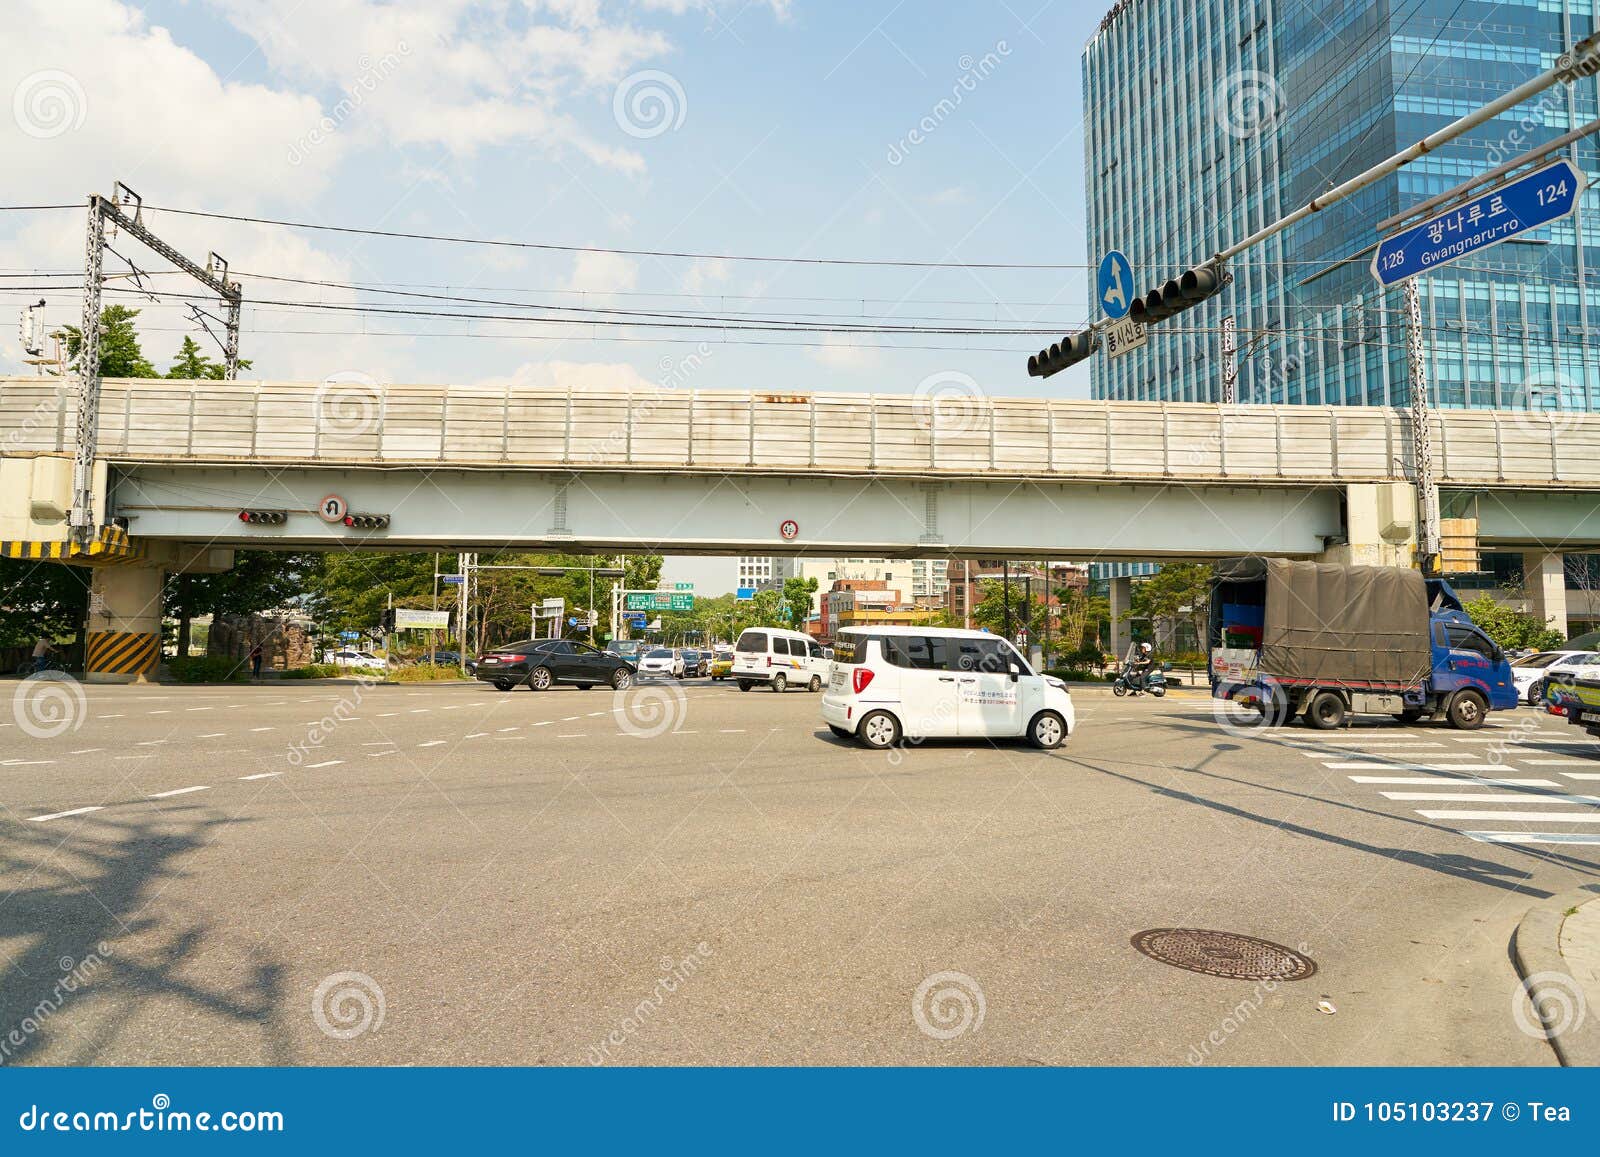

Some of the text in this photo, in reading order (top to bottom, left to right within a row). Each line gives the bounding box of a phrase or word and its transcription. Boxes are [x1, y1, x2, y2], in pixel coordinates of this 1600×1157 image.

[1536, 179, 1569, 207] 124
[1426, 195, 1508, 245] 광나루로
[1420, 218, 1519, 266] Gwangnaru-ro
[1381, 249, 1405, 271] 128
[1107, 322, 1145, 352] 동시신호
